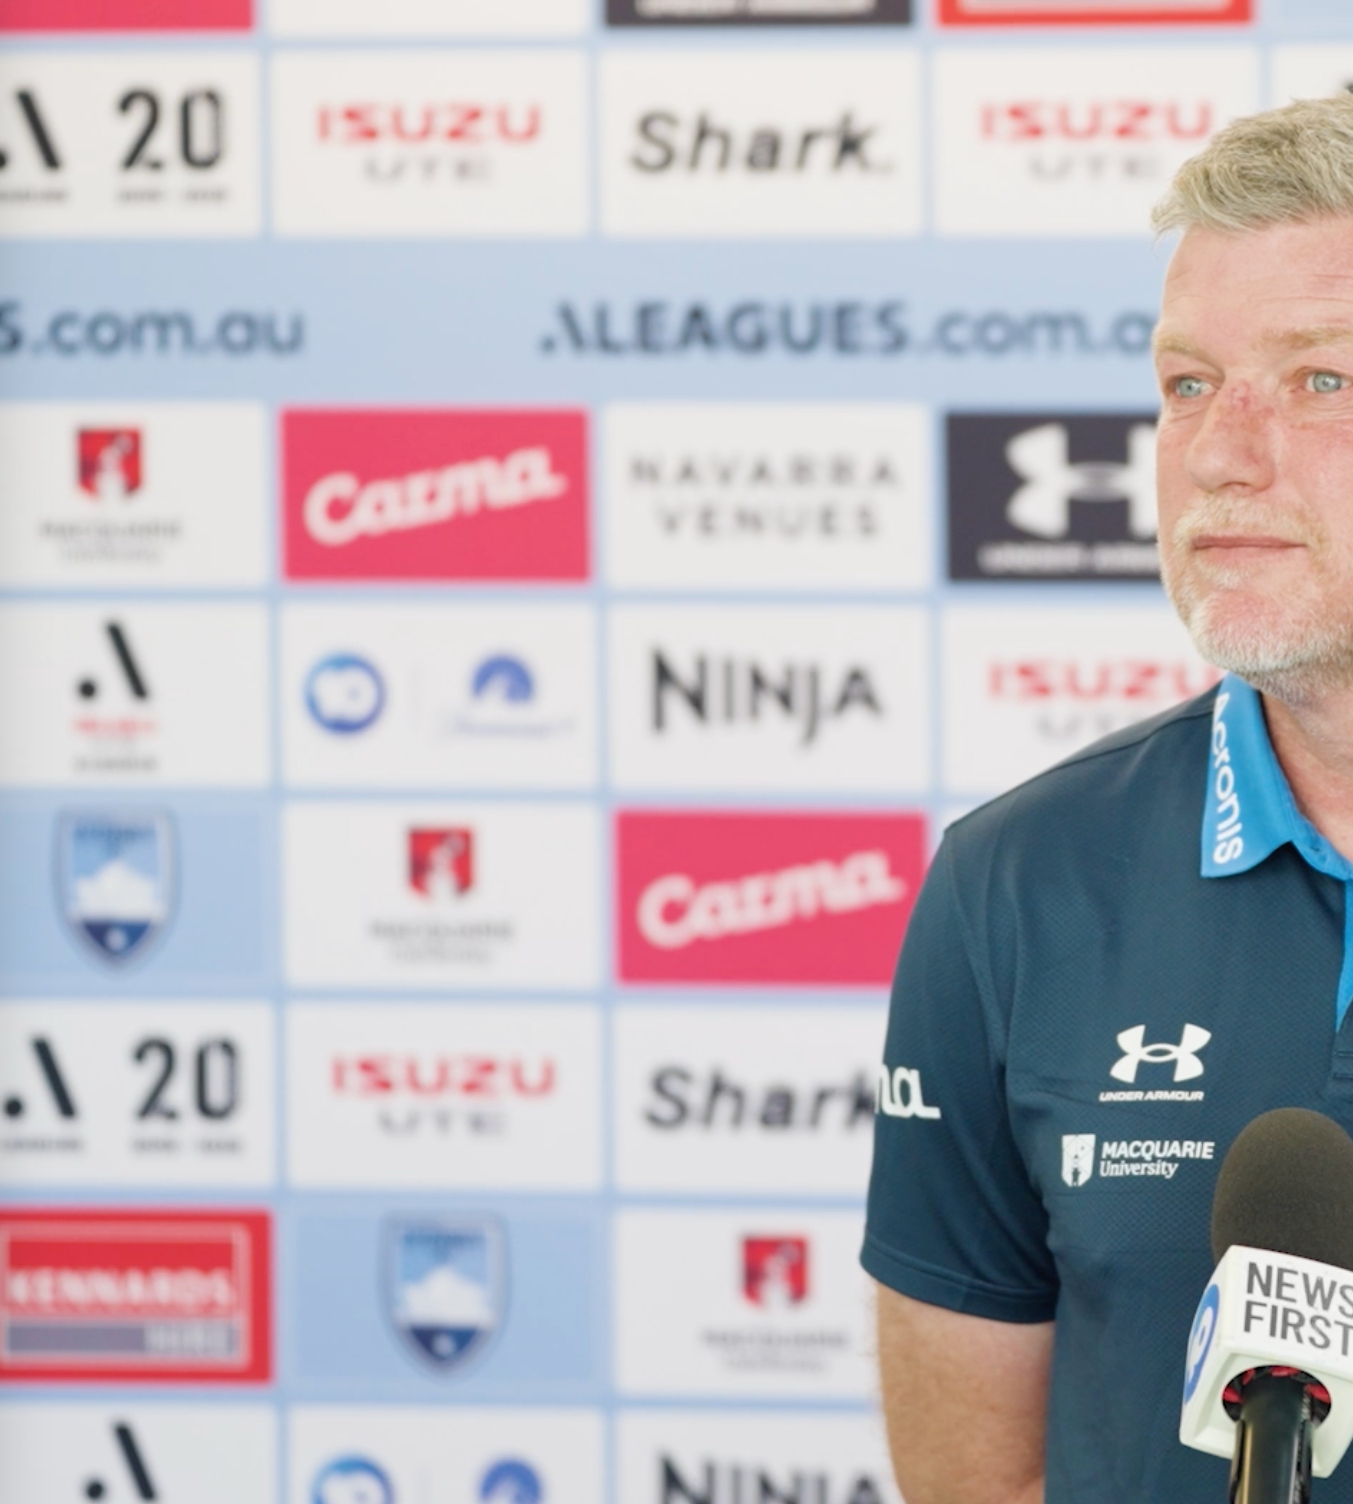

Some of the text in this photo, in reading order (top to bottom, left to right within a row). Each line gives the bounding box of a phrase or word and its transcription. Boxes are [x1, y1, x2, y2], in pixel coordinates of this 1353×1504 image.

[118, 90, 226, 170] 20
[317, 104, 541, 144] ISUZU
[981, 100, 1211, 140] ISUZU
[303, 447, 568, 545] Carma
[652, 645, 882, 746] NINJA
[989, 661, 1220, 699] ISUZU
[1213, 692, 1243, 864] Acronis
[636, 850, 907, 947] Carma
[131, 1037, 240, 1121] 20
[332, 1058, 556, 1095] ISUZU
[1099, 1090, 1204, 1102] UNDER ARMOUR
[1100, 1160, 1179, 1179] University
[1102, 1140, 1215, 1160] MACQUARIE
